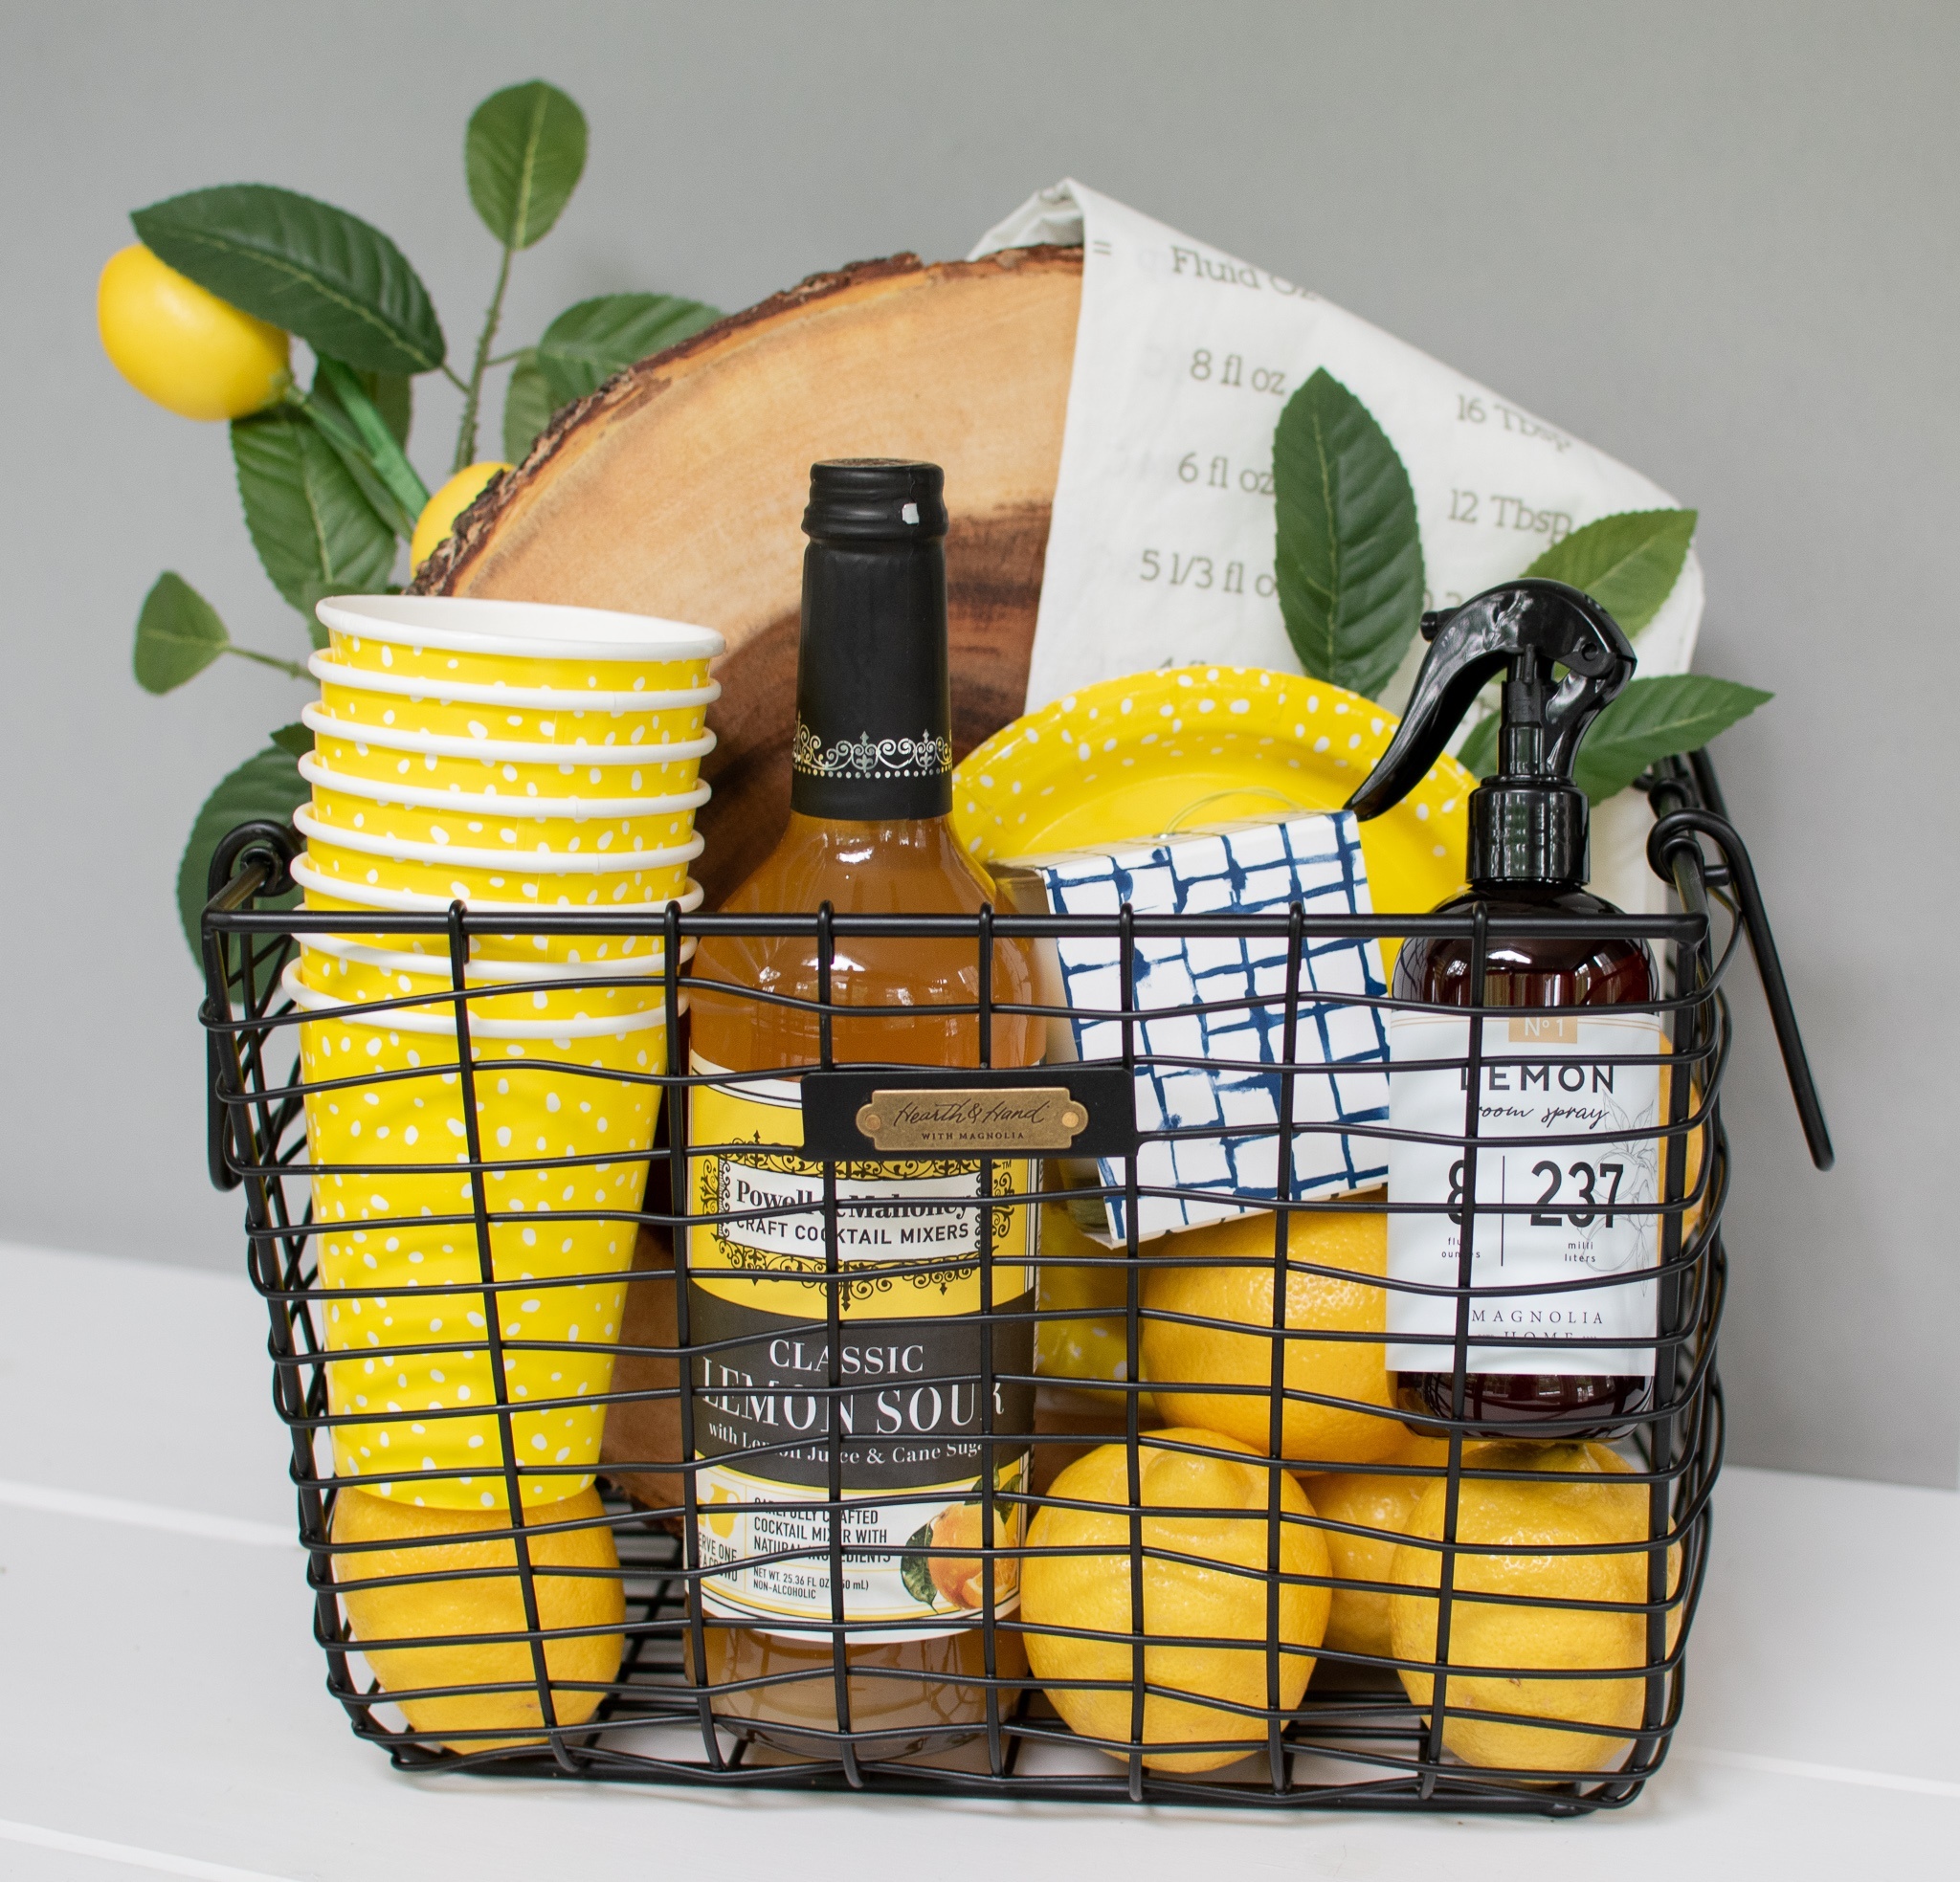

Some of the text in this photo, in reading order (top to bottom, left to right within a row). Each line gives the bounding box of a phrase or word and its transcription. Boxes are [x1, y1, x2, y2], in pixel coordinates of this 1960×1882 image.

[1170, 244, 1261, 290] Fluid
[1190, 347, 1286, 396] 8 fl oz
[1457, 393, 1486, 423] 16
[1177, 452, 1276, 496] 6 fl oz
[1448, 488, 1572, 545] 12 Tbsp
[1140, 548, 1278, 598] 5 1/3 fl o
[893, 1097, 1050, 1127] Hearth & Hand
[1541, 1105, 1610, 1130] spray
[922, 1131, 1025, 1140] WITH MAGNOLIA
[736, 1179, 814, 1215] Powell
[1530, 1160, 1624, 1229] 237
[901, 1223, 969, 1244] MIXERS
[1564, 1253, 1596, 1263] liters
[1471, 1309, 1603, 1325] MAGNOLIA
[769, 1339, 924, 1375] CLASSIC
[708, 1422, 738, 1445] with
[807, 1446, 859, 1464] Juce
[866, 1447, 885, 1465] &
[892, 1446, 941, 1463] Cane
[754, 1517, 887, 1543] COCKTAIL MIR WITH
[823, 1509, 879, 1524] CAFTED
[698, 1532, 716, 1556] ERVE
[719, 1543, 737, 1562] ONE
[753, 1566, 767, 1578] NET
[768, 1569, 781, 1582] WT.
[783, 1573, 804, 1585] 25.36
[807, 1576, 816, 1587] FL
[819, 1577, 830, 1588] OZ
[853, 1580, 869, 1591] mL)
[753, 1578, 816, 1600] NON-ALCOHOLIC
